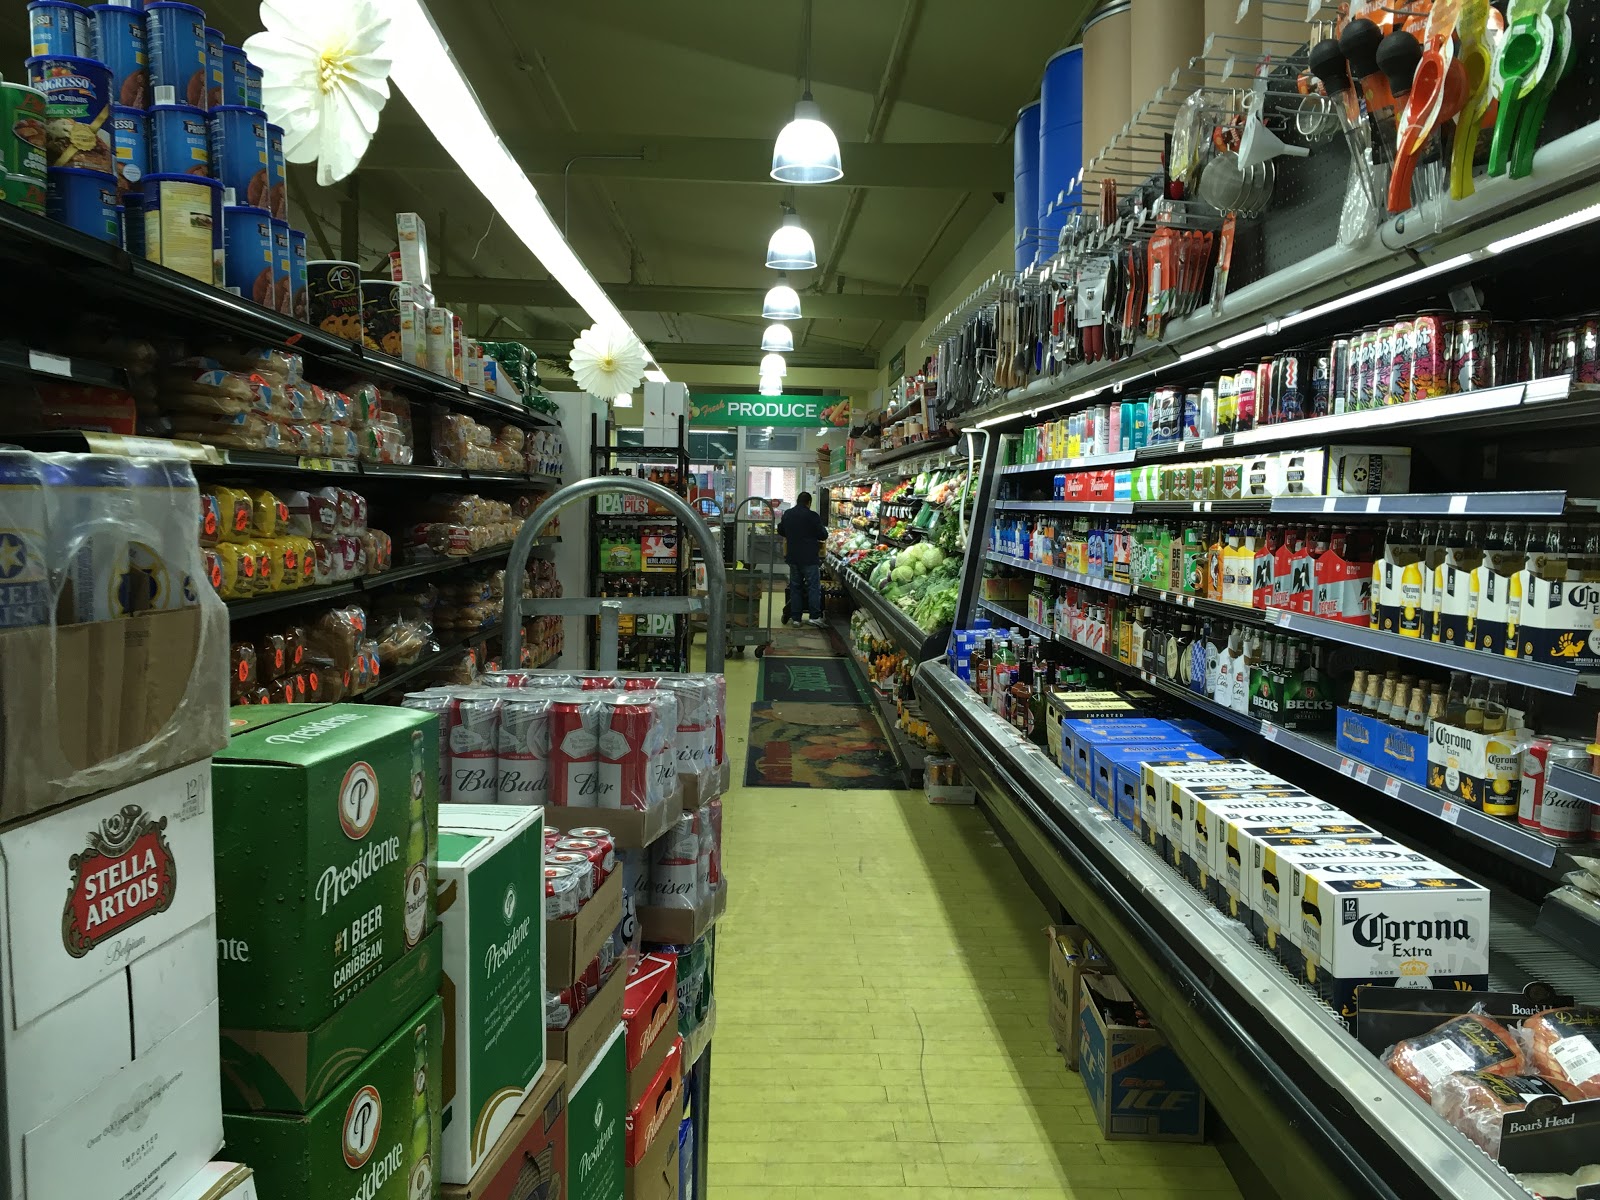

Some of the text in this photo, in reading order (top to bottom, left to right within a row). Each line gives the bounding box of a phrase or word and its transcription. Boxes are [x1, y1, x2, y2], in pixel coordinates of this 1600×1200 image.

[701, 400, 817, 418] Fresh PRODUCE
[597, 493, 621, 513] IPA
[624, 500, 645, 513] PILS
[1553, 584, 1559, 594] 6
[648, 614, 676, 634] IPA
[1253, 695, 1279, 712] BECK'S
[1286, 700, 1333, 710] BECK'S
[265, 713, 367, 744] Presidente
[1435, 726, 1472, 750] Corona
[1488, 755, 1518, 766] Corona
[186, 779, 198, 800] 12
[84, 848, 158, 900] STELLA
[315, 836, 400, 916] Presidente
[1323, 864, 1432, 875] Corona
[85, 874, 158, 930] ARTOIS
[1345, 900, 1355, 911] 12
[334, 904, 382, 957] #1 BEER
[1352, 912, 1471, 951] Corona
[105, 935, 146, 965] Belgium
[485, 916, 530, 979] Presidente
[1392, 943, 1432, 957] Extra
[333, 938, 383, 989] CARIBBEAN
[334, 964, 383, 1008] IMPORTED
[1509, 1113, 1575, 1133] Boar's Head
[122, 1133, 158, 1167] IMPORTED
[351, 1142, 403, 1200] sidente
